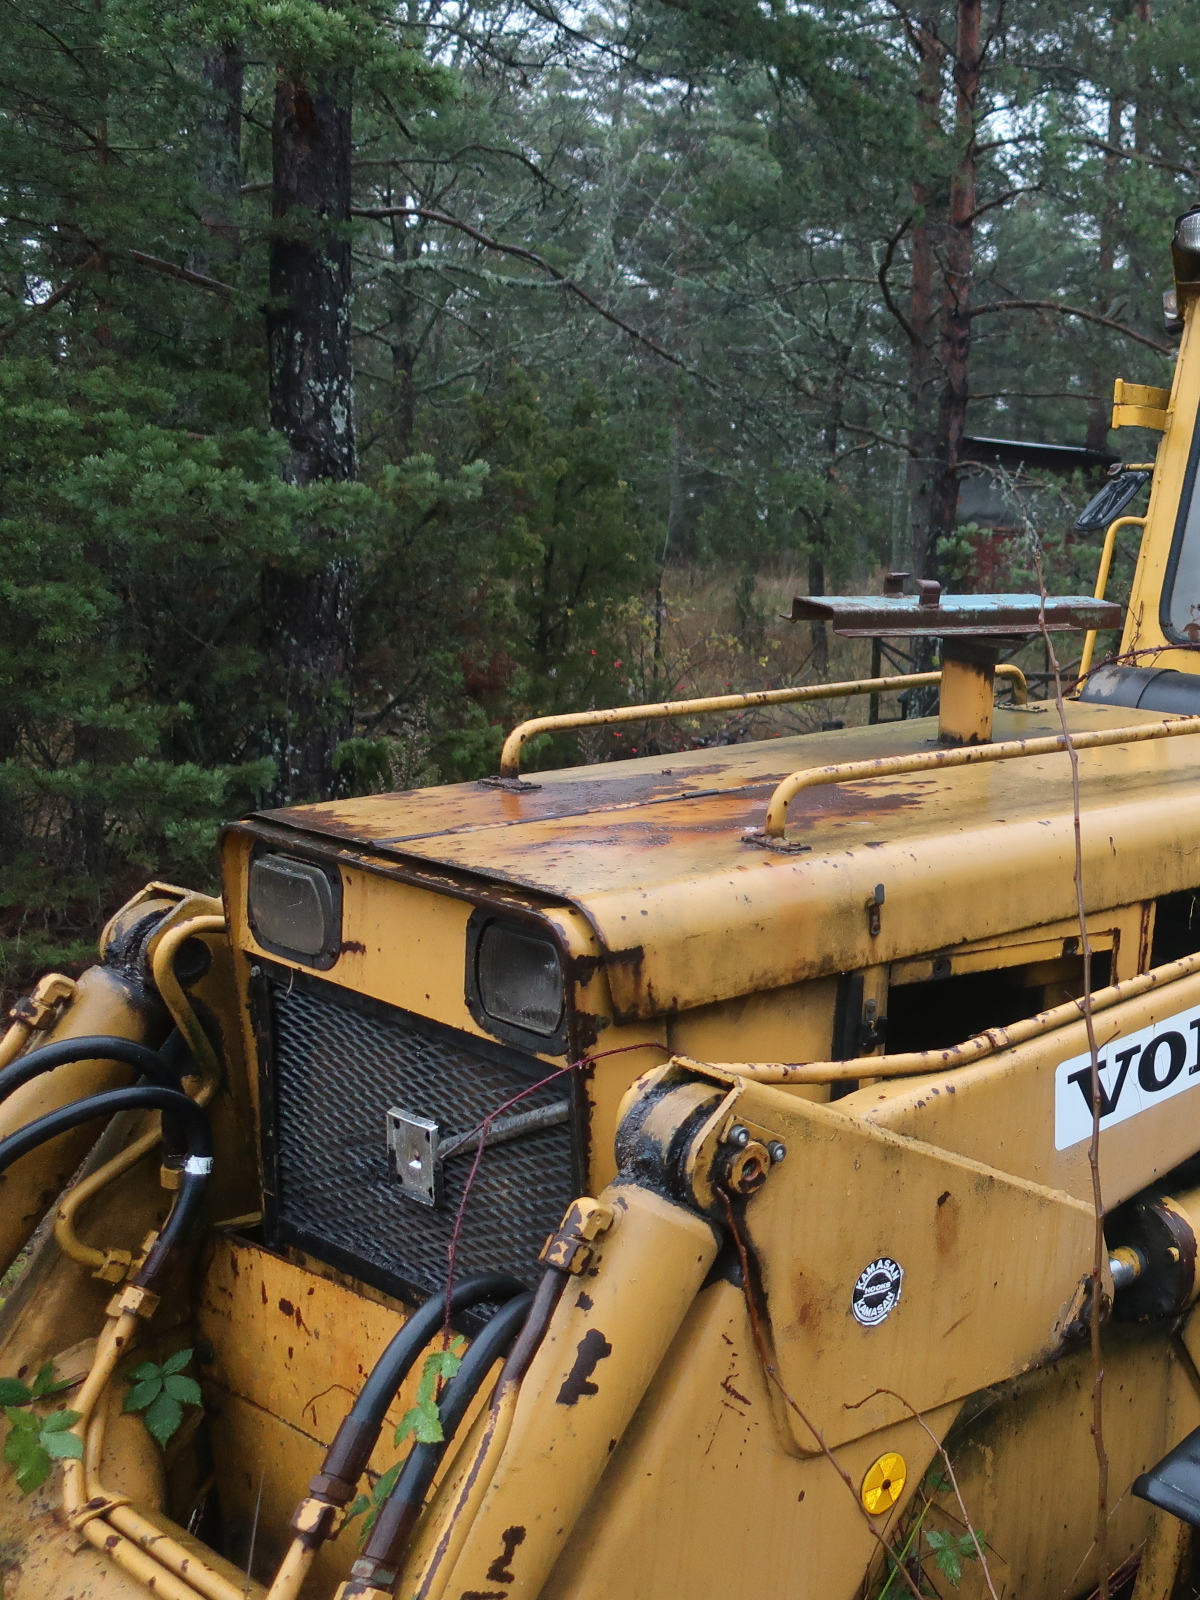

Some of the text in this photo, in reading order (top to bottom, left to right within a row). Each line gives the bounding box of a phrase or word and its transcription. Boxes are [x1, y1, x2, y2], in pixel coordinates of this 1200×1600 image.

[855, 1259, 899, 1290] KAMASAN
[865, 1281, 891, 1293] HOOKS
[856, 1291, 894, 1316] KAMASAN
